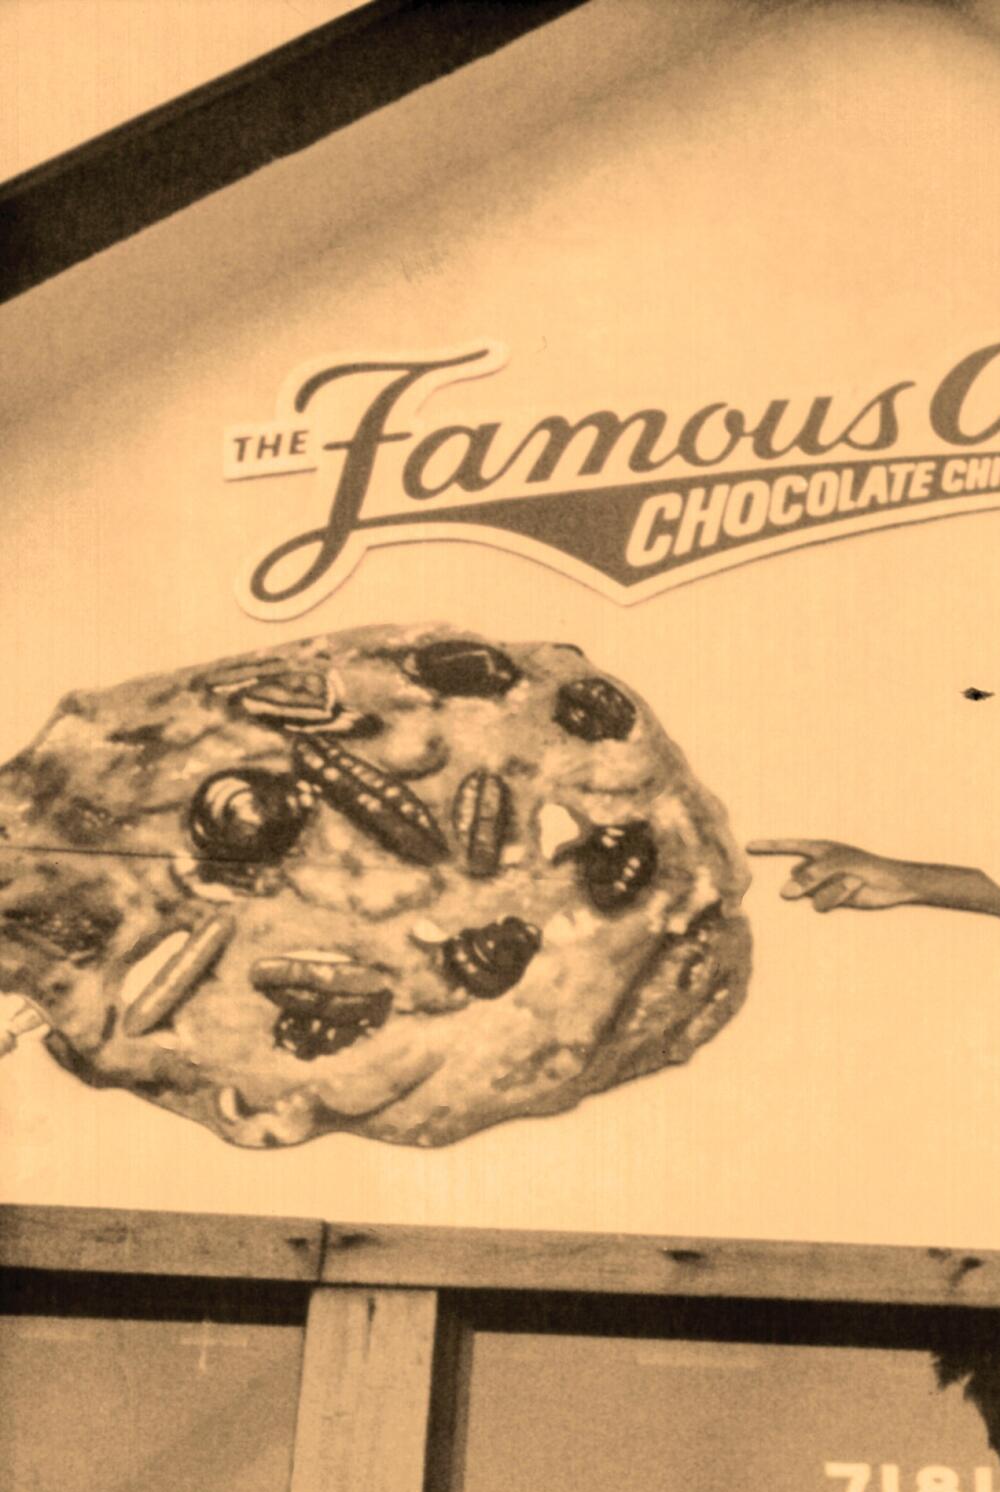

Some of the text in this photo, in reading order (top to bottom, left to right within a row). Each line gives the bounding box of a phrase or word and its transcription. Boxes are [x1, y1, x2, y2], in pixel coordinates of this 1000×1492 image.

[233, 429, 310, 463] THE
[250, 348, 916, 603] Famous
[626, 461, 936, 568] CHOCOLATE
